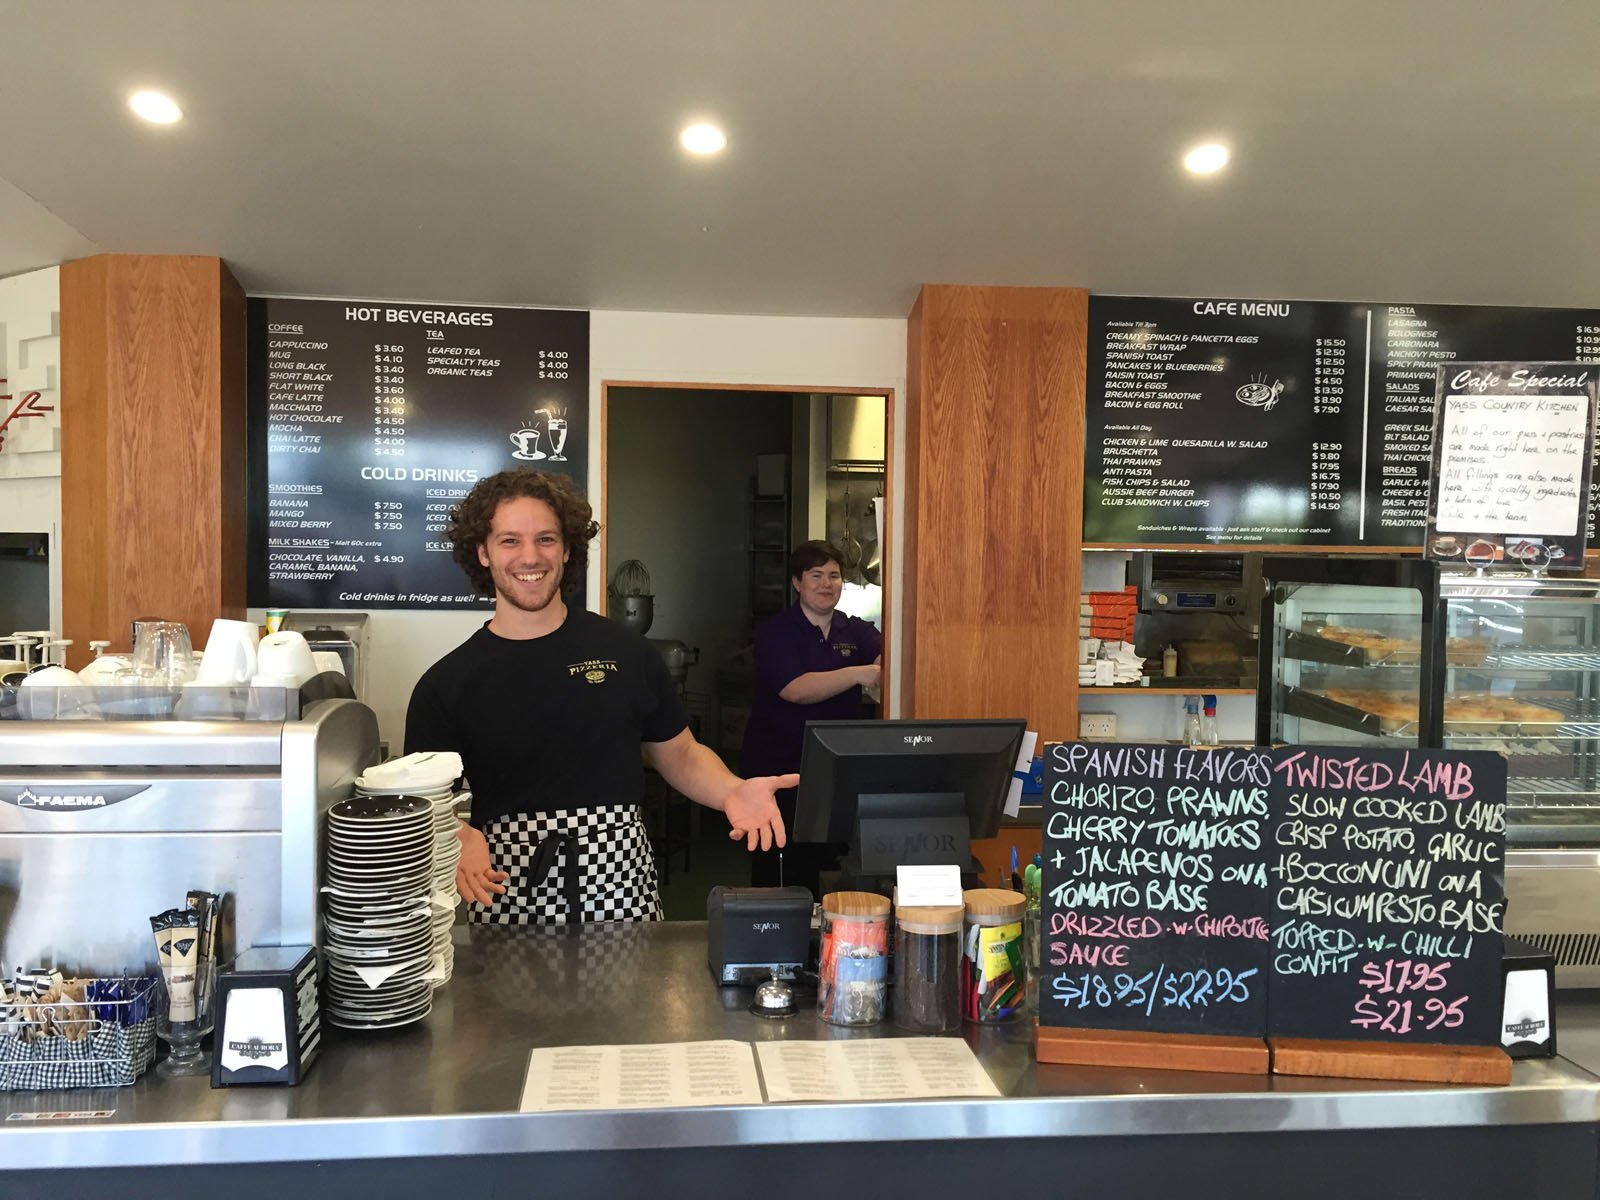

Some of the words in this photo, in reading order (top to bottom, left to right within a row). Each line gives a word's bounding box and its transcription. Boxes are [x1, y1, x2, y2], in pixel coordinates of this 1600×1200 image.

[1194, 302, 1237, 315] CAFE
[1241, 304, 1290, 316] MENU
[345, 307, 381, 322] HOT
[386, 310, 493, 326] BEVERAGES
[268, 324, 304, 332] COFFEE
[426, 330, 444, 338] TEA
[1106, 333, 1142, 341] CREAMY
[1144, 334, 1180, 342] SPINACH
[1191, 335, 1234, 343] PANCETTA
[269, 341, 328, 349] CAPPUCCINO
[1106, 343, 1158, 351] BREAKFAST
[269, 351, 291, 359] MUG
[428, 347, 461, 355] LEAFED
[463, 348, 481, 356] TEA
[1106, 352, 1144, 360] SPANISH
[1146, 353, 1173, 361] TOAST
[269, 362, 294, 370] LONG
[428, 357, 473, 366] SPECIALTY
[1106, 362, 1152, 370] PANCAKES
[269, 372, 298, 380] SHORT
[427, 368, 468, 376] ORGANIC
[1137, 372, 1164, 380] TOAST
[1105, 381, 1134, 389] BACON
[1145, 382, 1168, 390] EGGS
[1451, 370, 1500, 392] Cafe
[1508, 370, 1588, 391] Special
[294, 384, 324, 392] WHITE
[269, 393, 292, 401] CAFE
[294, 394, 324, 402] LATTE
[1105, 391, 1156, 399] BREAKFAST
[1157, 392, 1201, 400] SMOOTHIE
[269, 404, 322, 412] MACCHIATO
[269, 414, 288, 422] HOT
[290, 415, 343, 423] CHOCOLATE
[1103, 438, 1138, 446] CHICKEN
[1149, 439, 1168, 447] LIME
[1172, 440, 1224, 448] QUESADILLA
[1103, 448, 1158, 456] BRUSCHETTA
[1124, 458, 1162, 466] PRAWNS
[361, 467, 407, 481] COLD
[412, 468, 478, 482] DRINKS
[1125, 468, 1152, 476] PASTA
[1383, 466, 1417, 474] BREADS
[1103, 478, 1123, 486] FISH,
[269, 484, 322, 493] SMOOTHIES
[426, 489, 446, 497] ICED
[1159, 489, 1194, 497] BURGER
[269, 510, 304, 518] MANGO
[269, 520, 298, 528] MIXED
[300, 521, 332, 529] BERRY
[269, 538, 291, 546] MILK
[293, 538, 330, 546] SHAKES
[269, 553, 324, 563] CHOCOLATE,
[326, 554, 365, 563] VANILLA,
[269, 563, 316, 571] CARAMEL,
[317, 564, 358, 572] BANANA,
[269, 572, 334, 581] STRAWBERRY
[339, 592, 361, 601] Cold
[364, 593, 395, 602] drinks
[408, 593, 438, 604] fridge
[569, 663, 618, 675] PIZZERIA
[1052, 744, 1165, 779] SPANISH
[1174, 748, 1273, 787] FLAVORS
[1274, 751, 1393, 792] TWISTED
[1398, 751, 1475, 800] LAMB
[39, 795, 106, 806] FAEMA
[1285, 793, 1347, 820] SLOW
[1353, 797, 1447, 825] COOKED
[1047, 812, 1145, 845] CHERRY
[1148, 819, 1261, 850] TOMATOES
[1275, 820, 1337, 850] CRISP
[1428, 832, 1501, 862] GARLIC
[1072, 846, 1214, 883] JALAPENOS
[1049, 879, 1140, 910] TOMATO
[1146, 880, 1209, 912] BASE
[1440, 900, 1503, 934] BASE
[1049, 911, 1162, 938] DRIZZLED
[1272, 918, 1357, 951] TOPPED
[1401, 930, 1473, 959] CHILLI
[1050, 942, 1130, 968] SAUCE
[1274, 950, 1358, 976] CONFIT
[1358, 959, 1452, 994] $17.95
[1350, 994, 1469, 1034] $21.95
